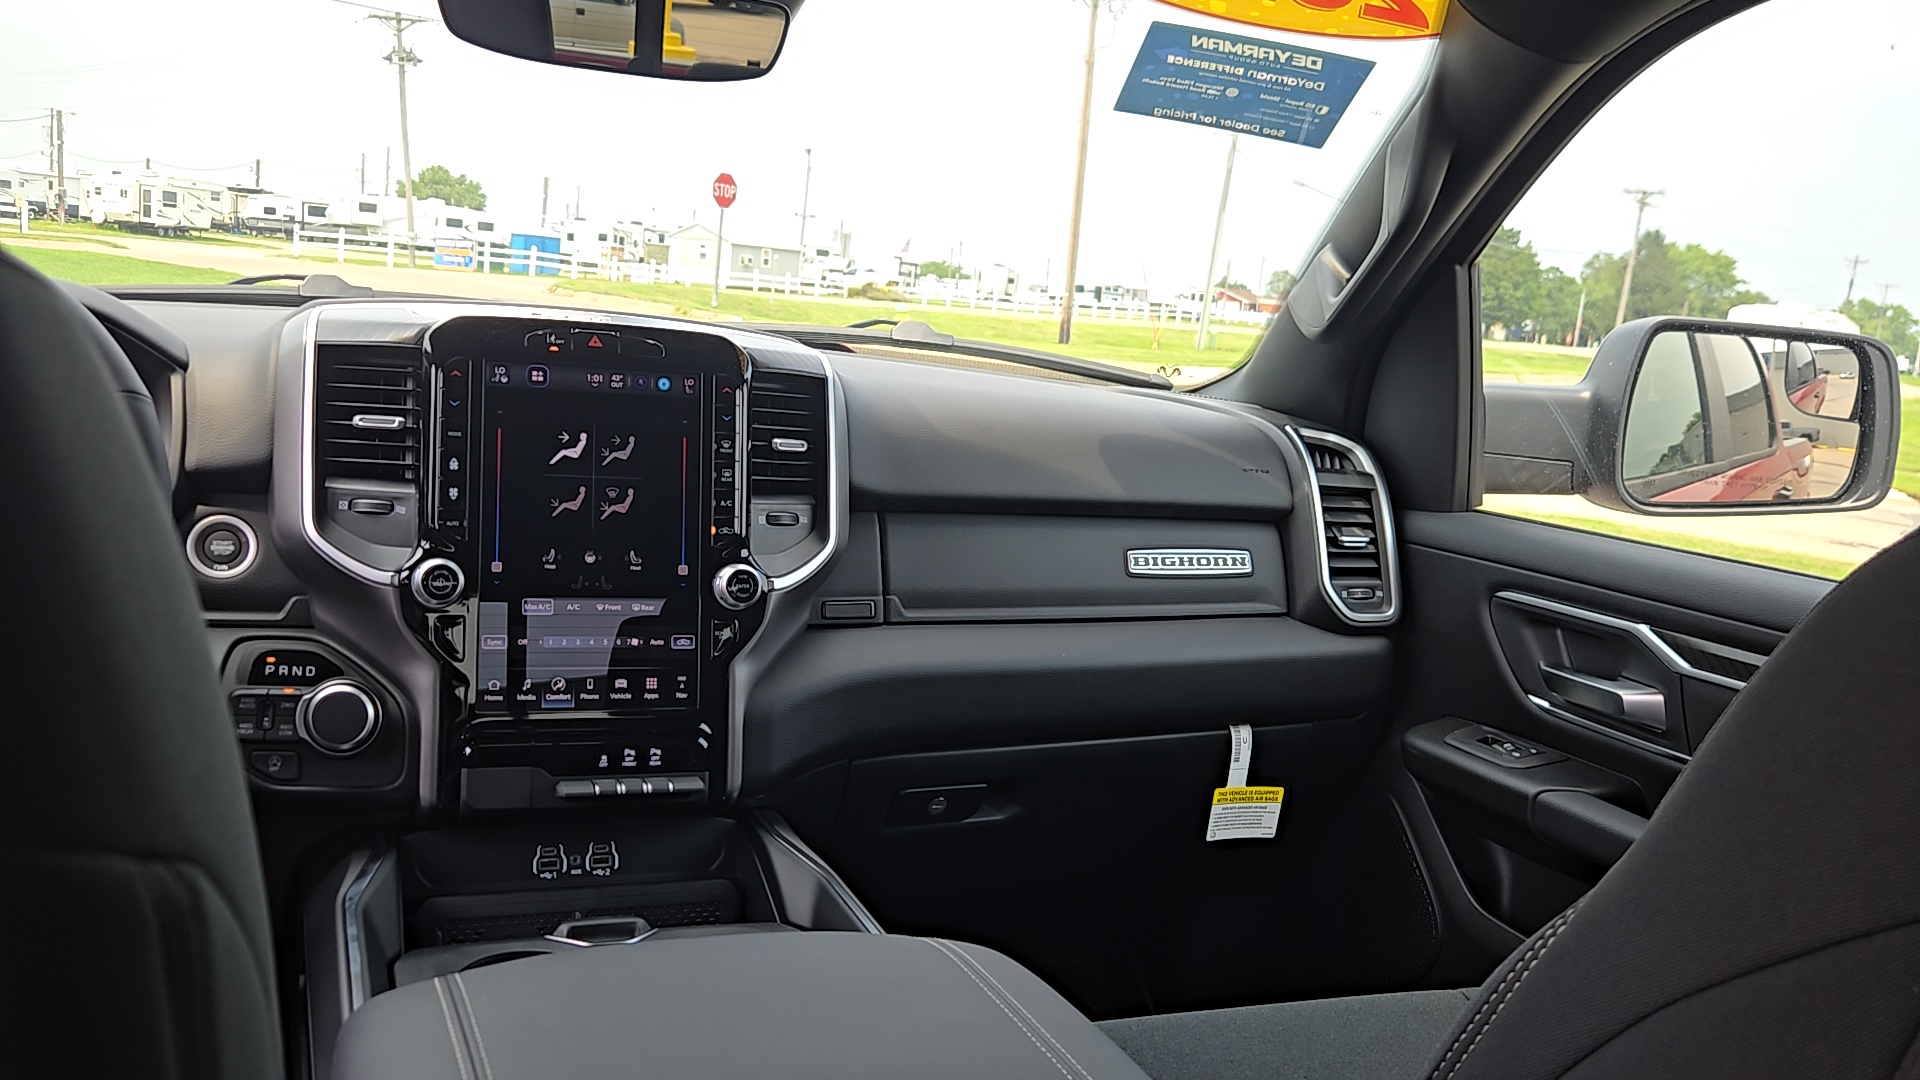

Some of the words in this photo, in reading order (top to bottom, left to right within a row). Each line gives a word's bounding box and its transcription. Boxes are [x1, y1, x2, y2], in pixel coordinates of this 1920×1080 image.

[713, 182, 736, 199] STOP
[586, 373, 603, 382] 1:01
[1132, 555, 1248, 568] BIGHORN
[538, 603, 551, 611] A/C
[567, 603, 581, 611] A/C
[604, 603, 622, 611] Front
[486, 638, 502, 647] Sync
[649, 638, 664, 646] Auto
[517, 693, 536, 701] Media
[546, 692, 571, 701] Comfort
[580, 692, 599, 700] Phone
[610, 692, 632, 700] Vehicle
[644, 692, 659, 701] Apps
